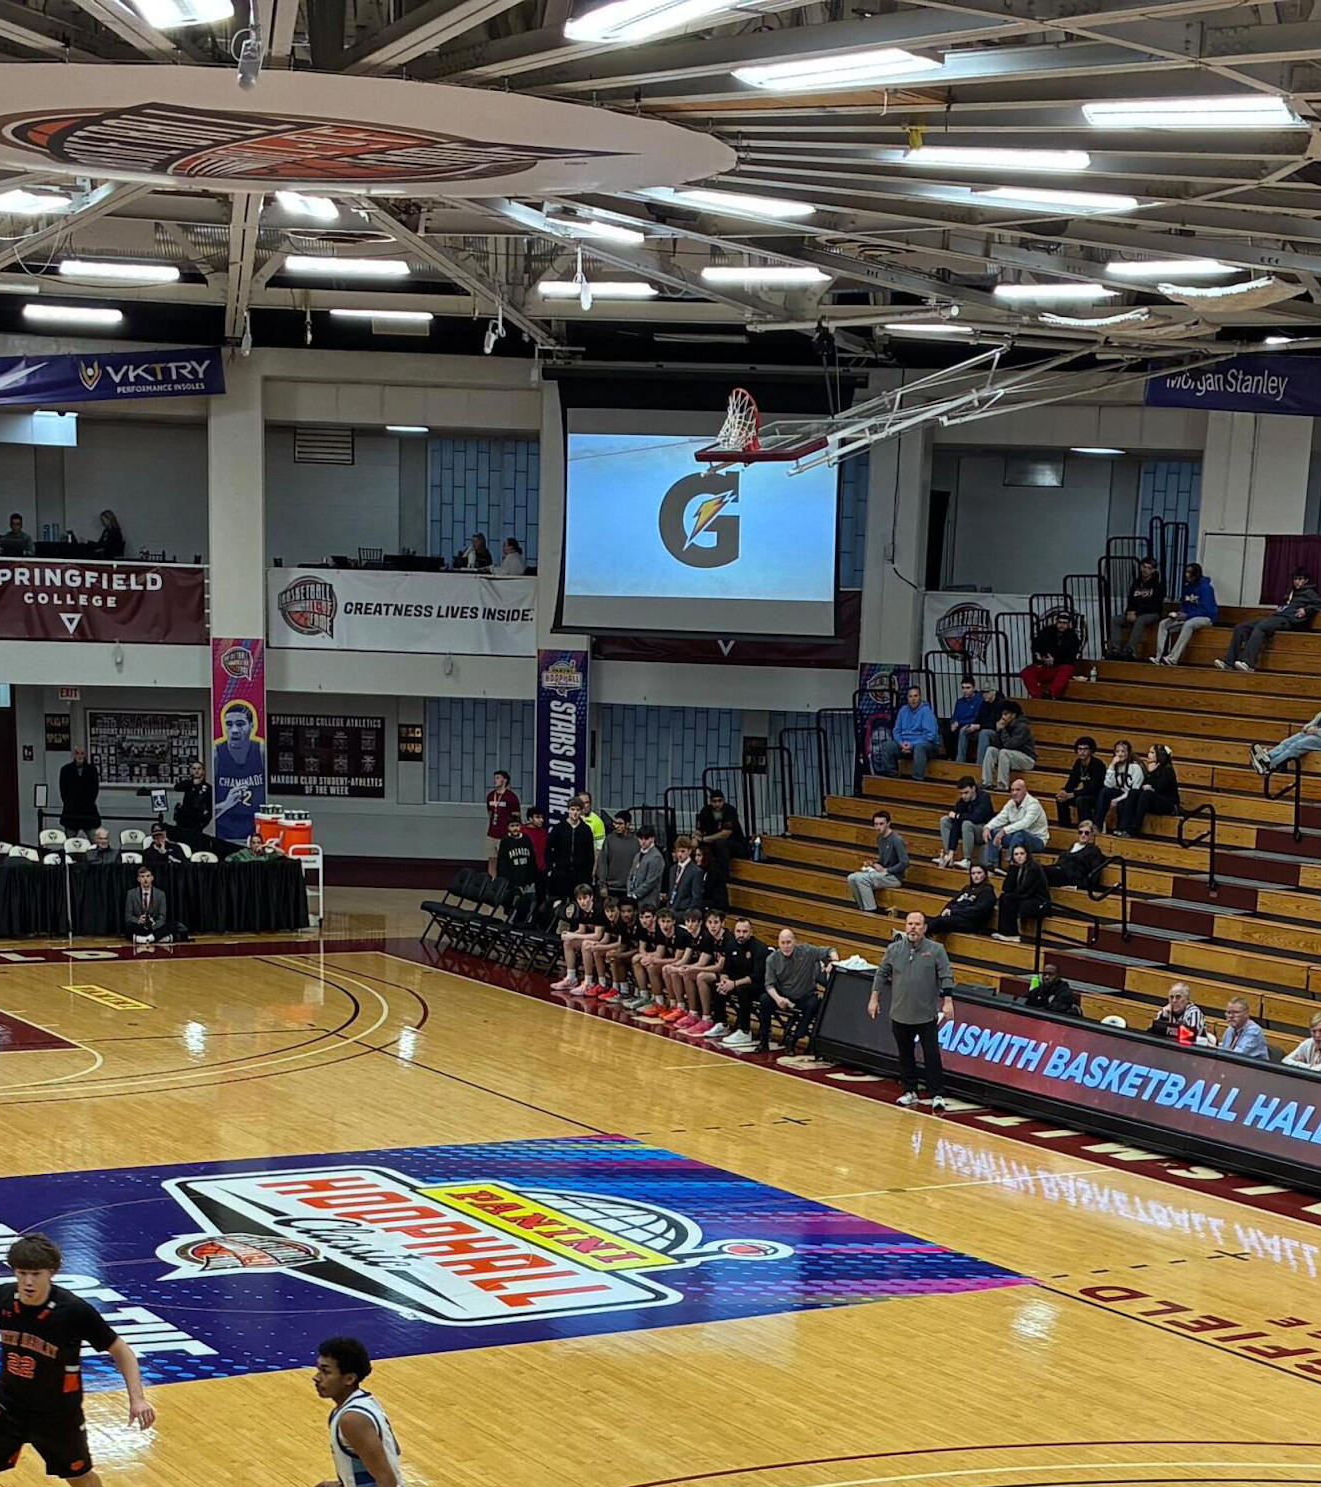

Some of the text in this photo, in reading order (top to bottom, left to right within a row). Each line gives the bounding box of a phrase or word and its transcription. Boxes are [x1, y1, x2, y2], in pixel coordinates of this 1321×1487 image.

[105, 359, 212, 384] VKTRY
[1226, 368, 1289, 401] Stanley
[658, 471, 740, 568] G
[23, 592, 117, 608] COLLEGE
[343, 601, 433, 618] GREATNESS
[436, 602, 479, 620] LIVES
[549, 700, 577, 757] STARS
[549, 759, 576, 783] OF
[918, 1013, 1046, 1073] AISMITH
[1042, 1045, 1237, 1122] BASKETBALL
[257, 1175, 612, 1309] HOOPHALL
[272, 1216, 414, 1269] Classic
[451, 1189, 650, 1266] PANINI
[6, 1351, 37, 1380] 22
